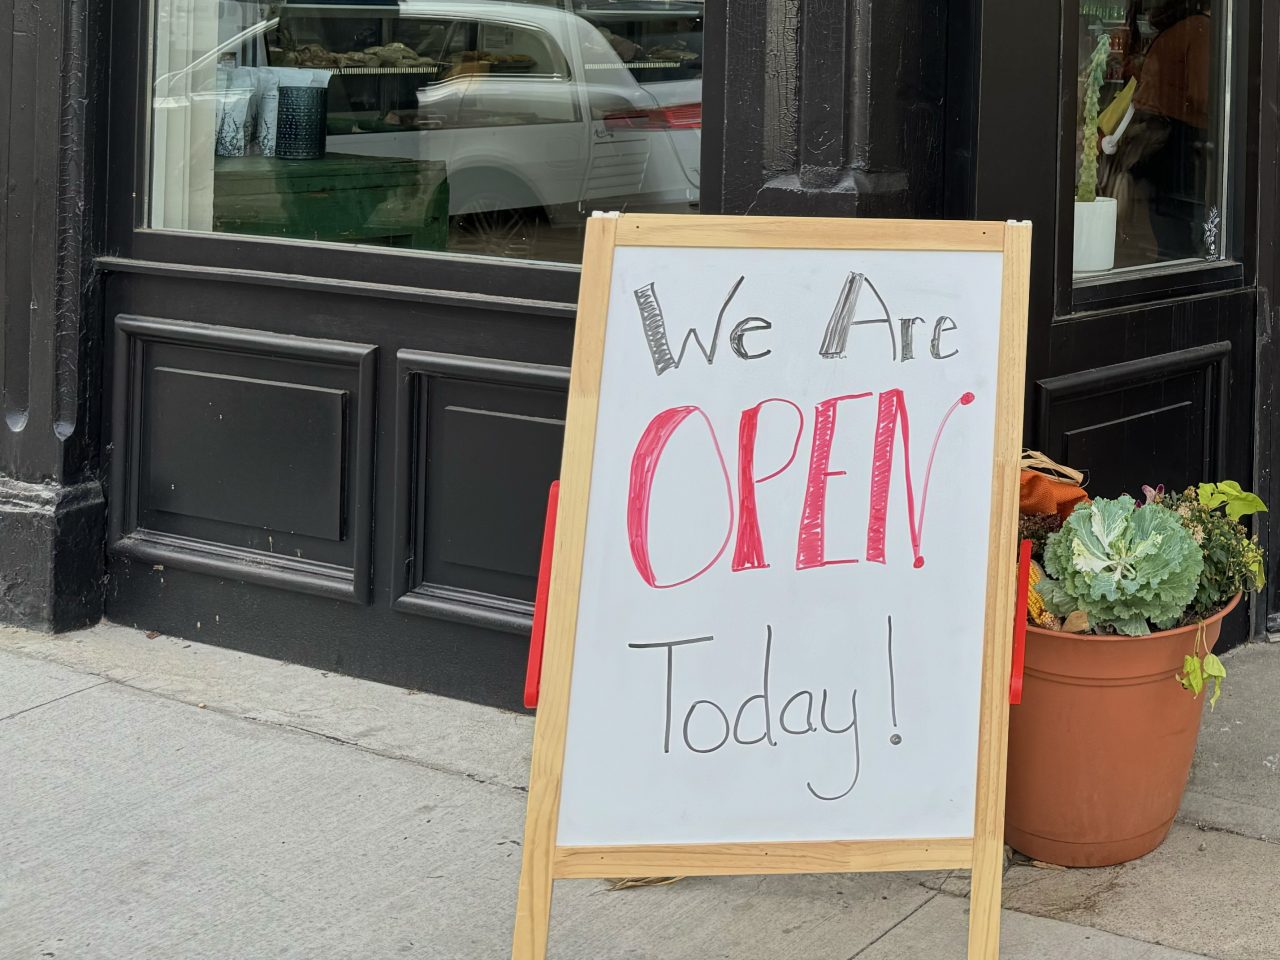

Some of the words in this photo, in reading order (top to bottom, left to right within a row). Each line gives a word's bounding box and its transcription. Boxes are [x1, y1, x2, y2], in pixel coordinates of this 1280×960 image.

[634, 276, 772, 376] We
[818, 271, 959, 363] Are
[626, 387, 976, 589] OPEN
[627, 615, 902, 801] Today!
